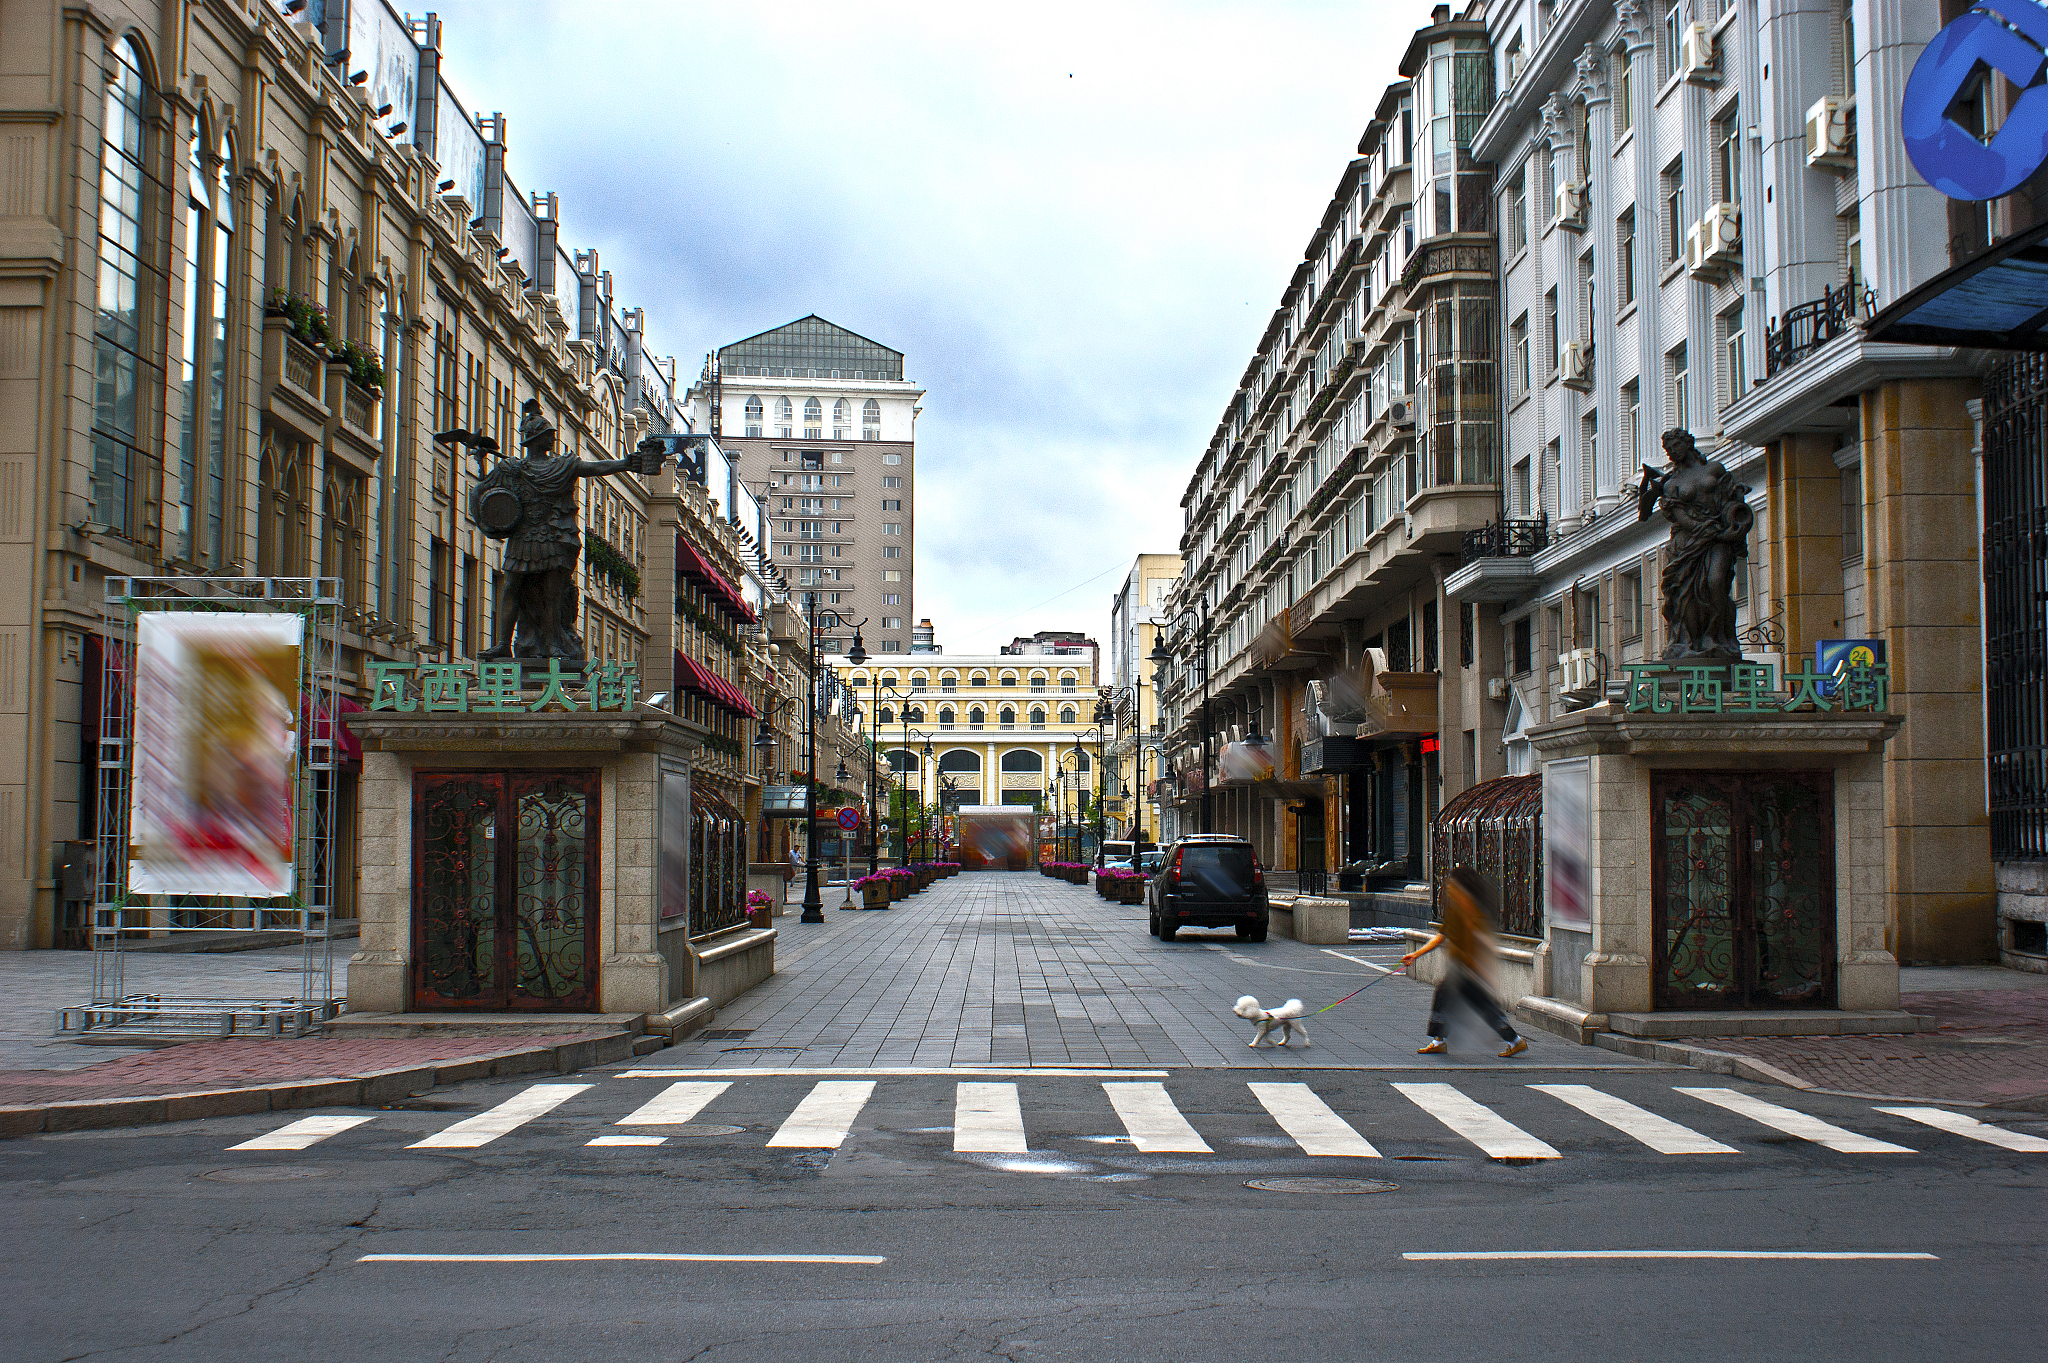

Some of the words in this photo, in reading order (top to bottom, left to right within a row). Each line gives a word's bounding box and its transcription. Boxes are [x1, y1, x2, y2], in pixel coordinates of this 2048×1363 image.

[1852, 650, 1868, 661] 24
[365, 657, 639, 713] 瓦西里大街
[1621, 659, 1889, 713] 瓦西里大街
